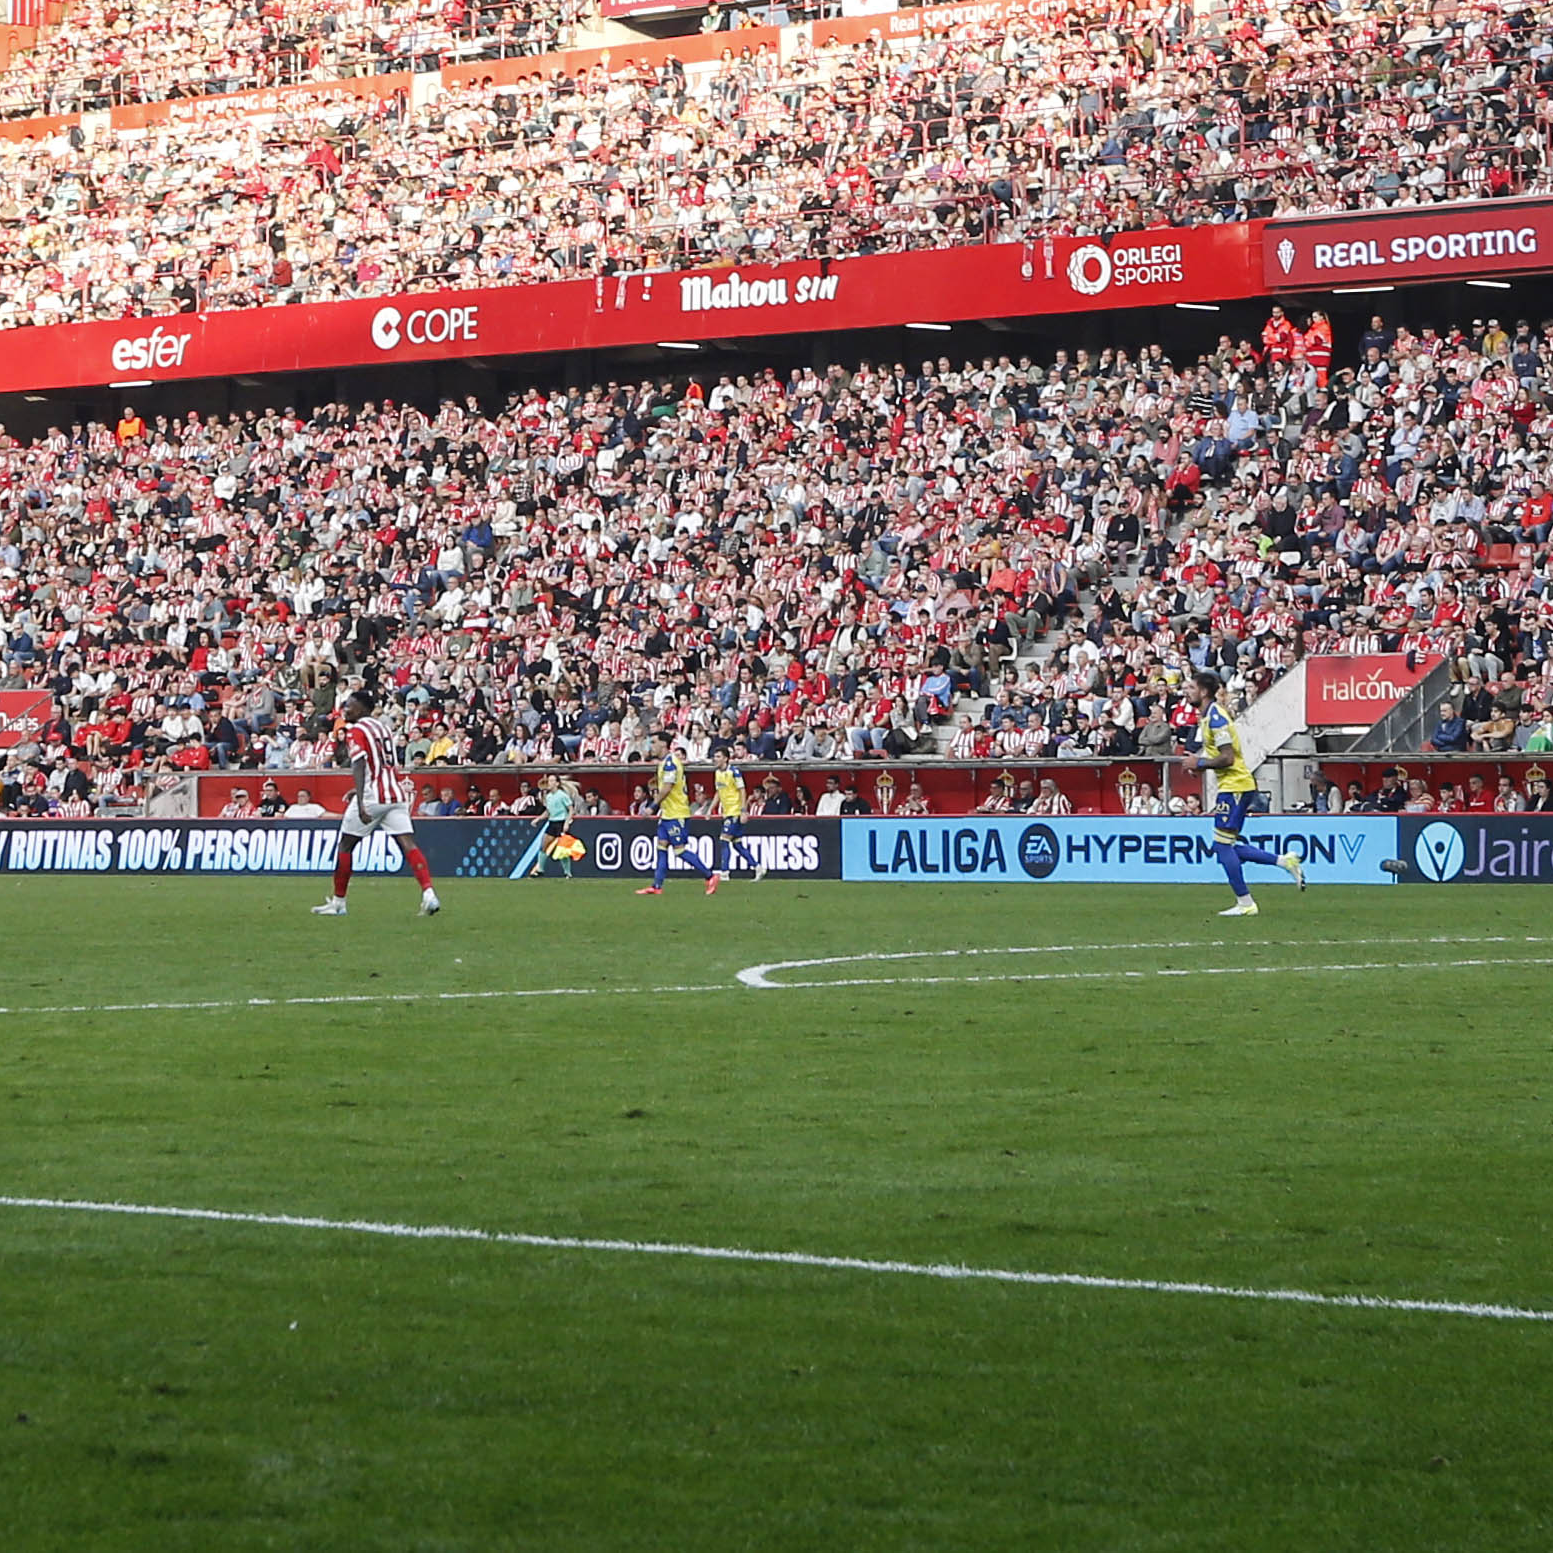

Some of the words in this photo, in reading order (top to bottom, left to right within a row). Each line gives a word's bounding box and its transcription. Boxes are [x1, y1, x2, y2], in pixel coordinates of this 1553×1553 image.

[889, 13, 919, 34] Real
[1006, 0, 1025, 18] de
[169, 100, 193, 119] Real
[261, 92, 278, 110] de
[1111, 243, 1182, 270] ORLEGI
[1312, 239, 1384, 270] REAL
[1389, 226, 1537, 263] SPORTING
[679, 271, 789, 312] Mahou
[793, 275, 839, 304] SIN
[1111, 261, 1183, 287] SPORTS
[405, 303, 479, 344] COPE
[111, 325, 192, 373] esfer
[8, 829, 114, 871] RUTINAS
[117, 828, 183, 871] 100%
[184, 829, 404, 872] PERSONALIZDAS
[867, 828, 1007, 874] LALIGA
[1026, 835, 1053, 855] EA
[1065, 833, 1336, 865] HYPERMTION
